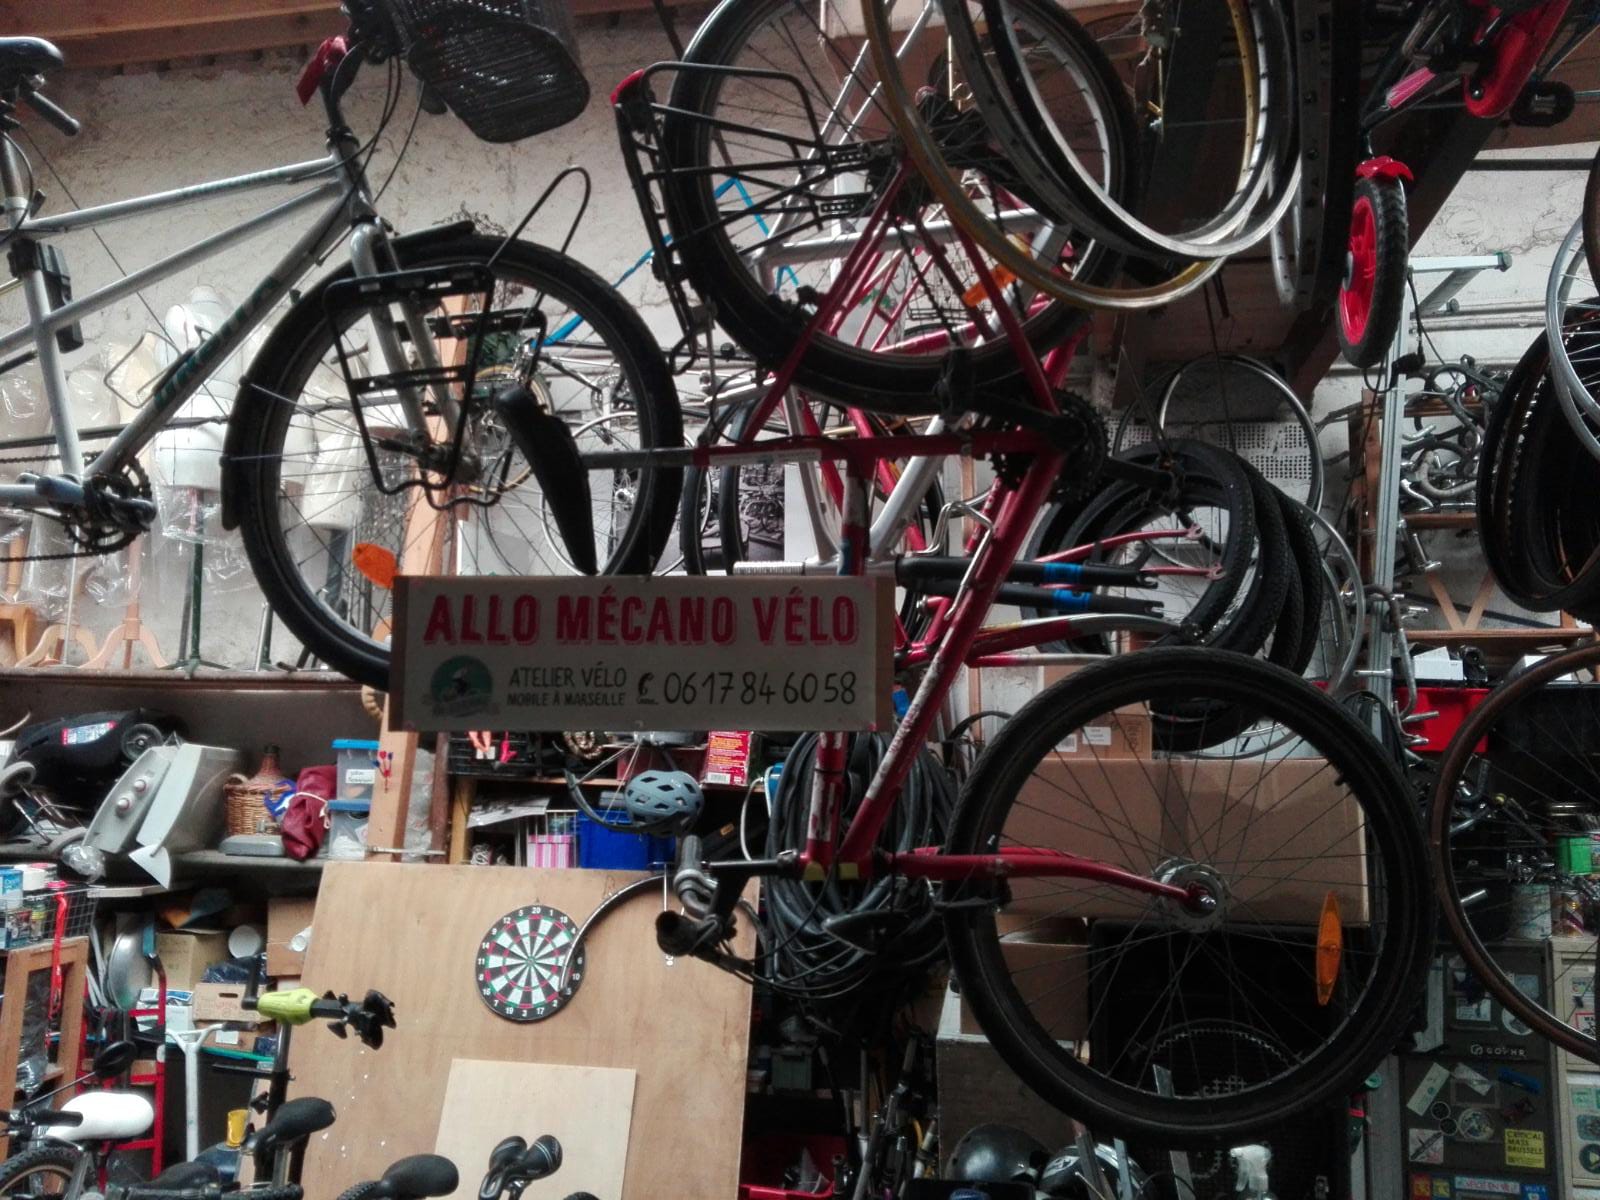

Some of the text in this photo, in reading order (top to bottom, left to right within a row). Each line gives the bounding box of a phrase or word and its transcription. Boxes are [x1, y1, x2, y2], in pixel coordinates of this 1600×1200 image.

[424, 585, 859, 646] ALLO MÉCANO VÉLO
[509, 660, 627, 689] ATELIER VÉLO
[507, 691, 548, 706] MOBILE
[563, 691, 626, 706] MARSEILLE
